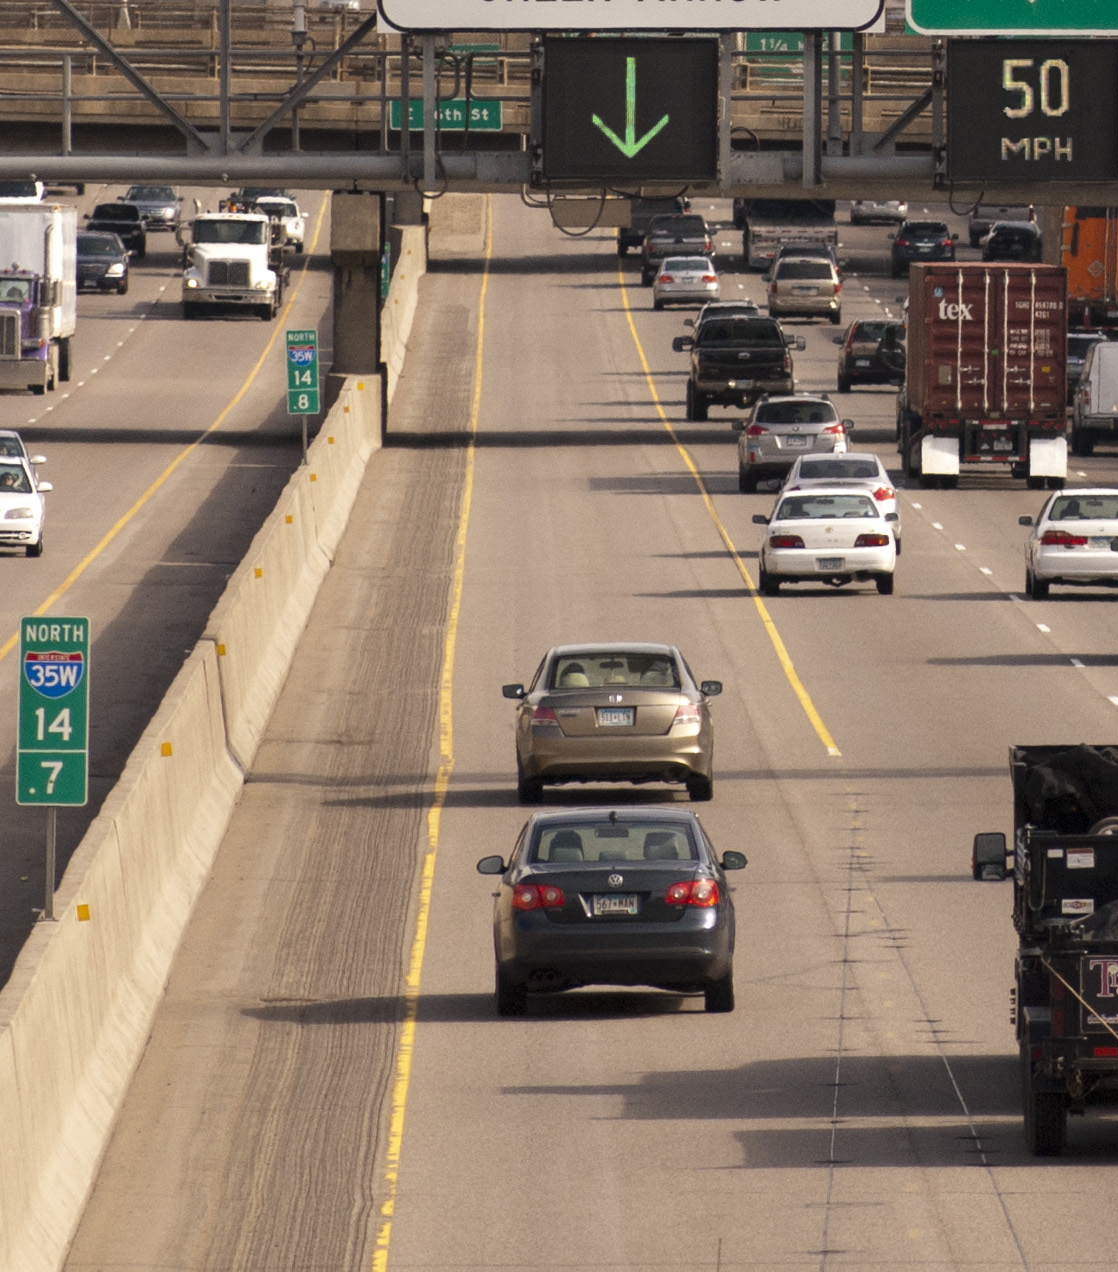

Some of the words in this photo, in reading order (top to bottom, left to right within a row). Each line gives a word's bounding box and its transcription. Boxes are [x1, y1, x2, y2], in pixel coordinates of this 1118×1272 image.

[1002, 58, 1070, 118] 50
[470, 108, 489, 121] St
[1001, 136, 1073, 162] MPH
[938, 298, 973, 321] tex
[287, 332, 316, 342] NORTH
[291, 350, 313, 362] 35W
[294, 370, 312, 386] 14
[292, 393, 310, 410] .8
[25, 624, 85, 643] NORTH
[31, 665, 78, 688] 35W
[35, 707, 73, 741] 14
[28, 761, 64, 795] .7
